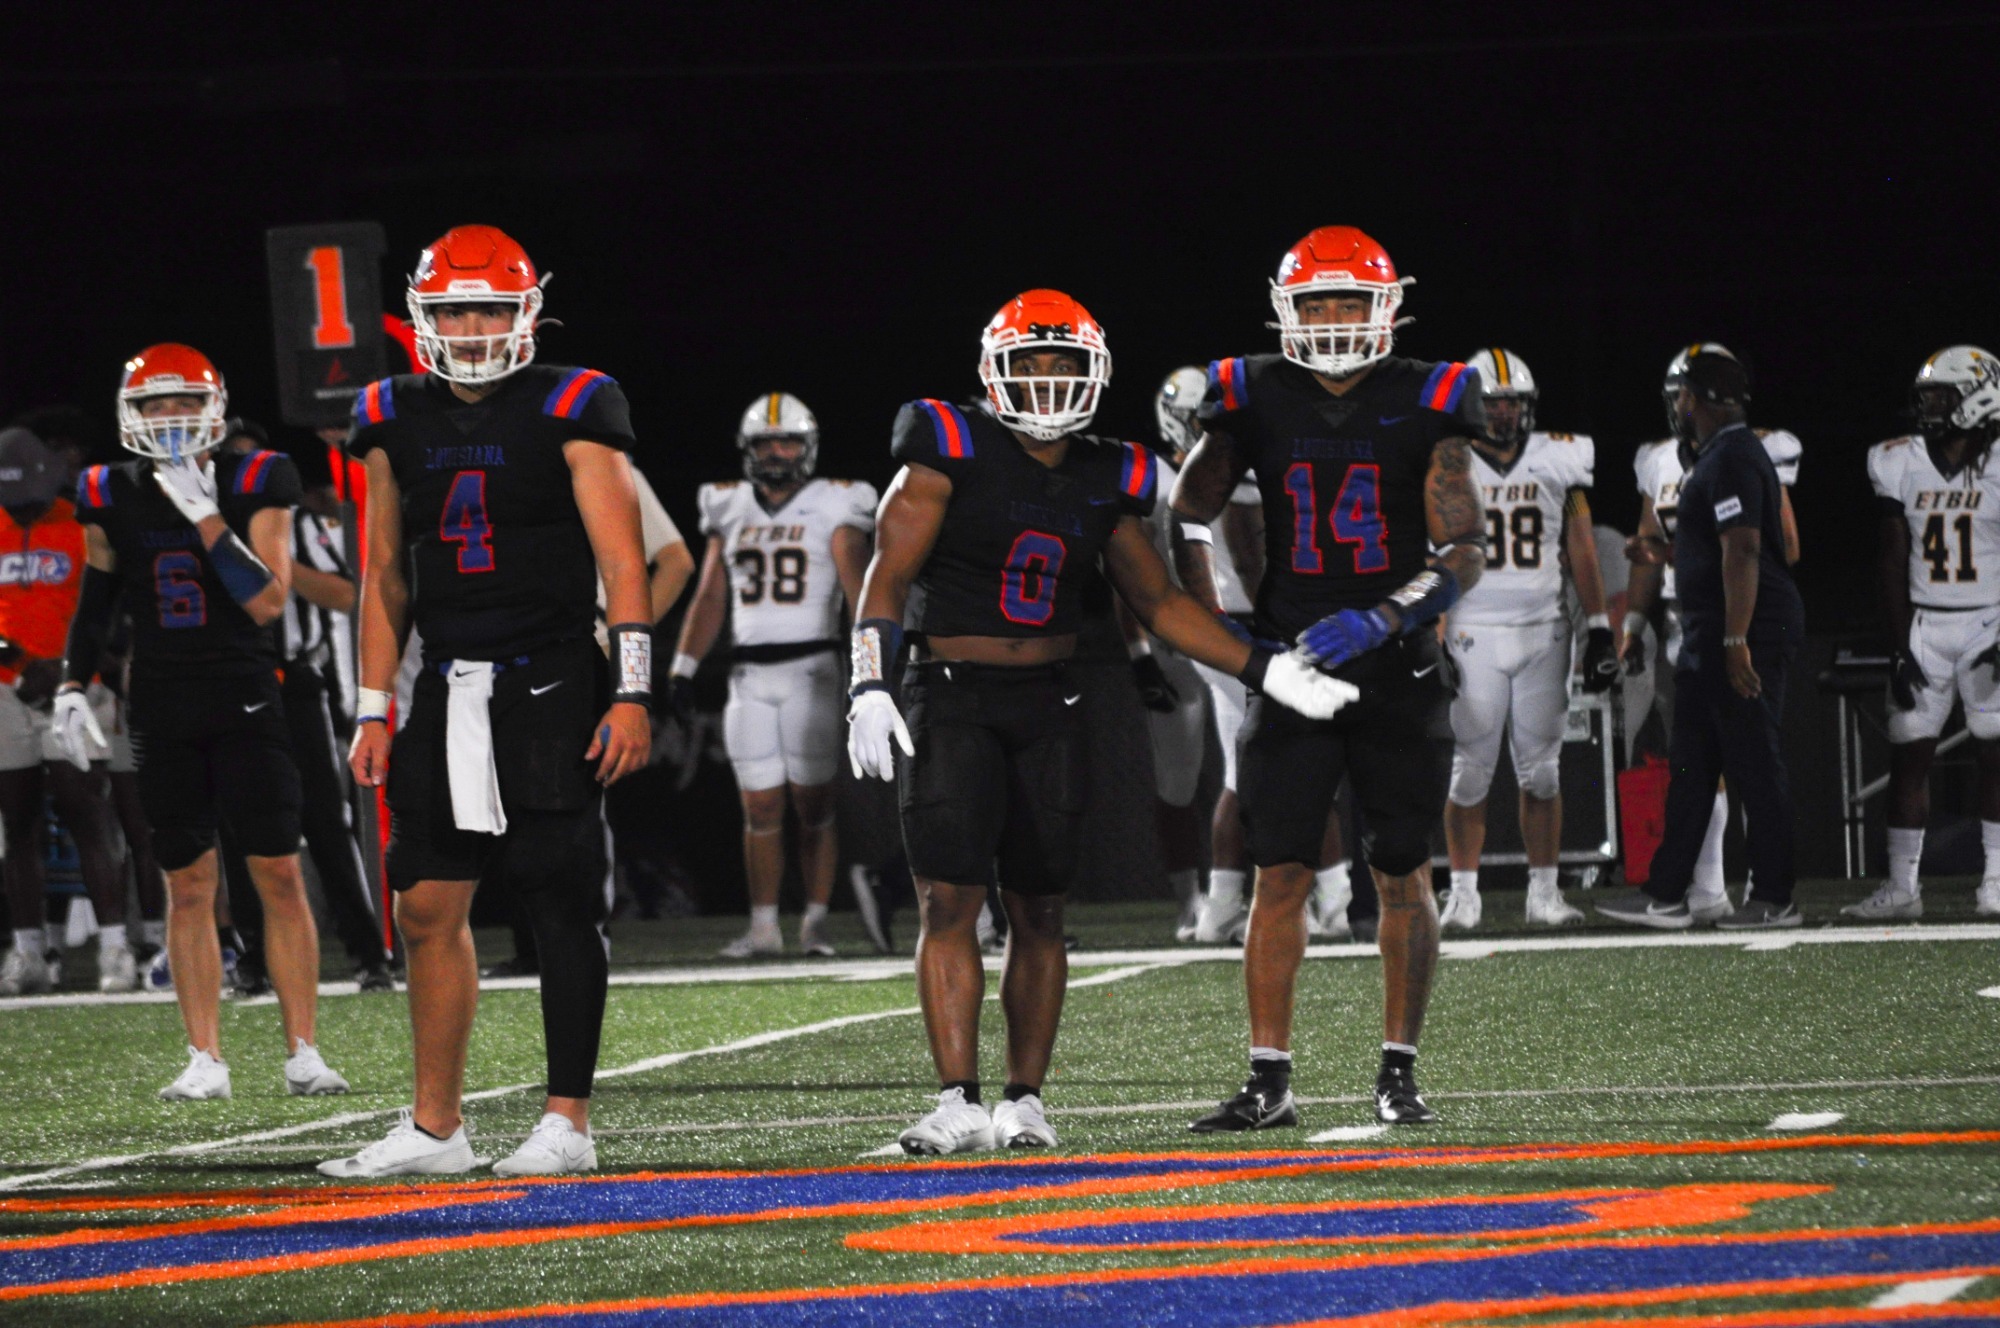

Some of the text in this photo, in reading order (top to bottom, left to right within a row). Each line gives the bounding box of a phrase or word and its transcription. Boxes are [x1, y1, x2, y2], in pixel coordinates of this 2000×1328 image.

[305, 246, 356, 349] 1
[440, 469, 496, 574] 4
[1283, 462, 1391, 575] 14
[1914, 490, 1983, 510] ETBU
[152, 549, 208, 629] 6
[734, 545, 809, 606] 38
[999, 529, 1068, 627] 0
[1922, 511, 1979, 583] 41
